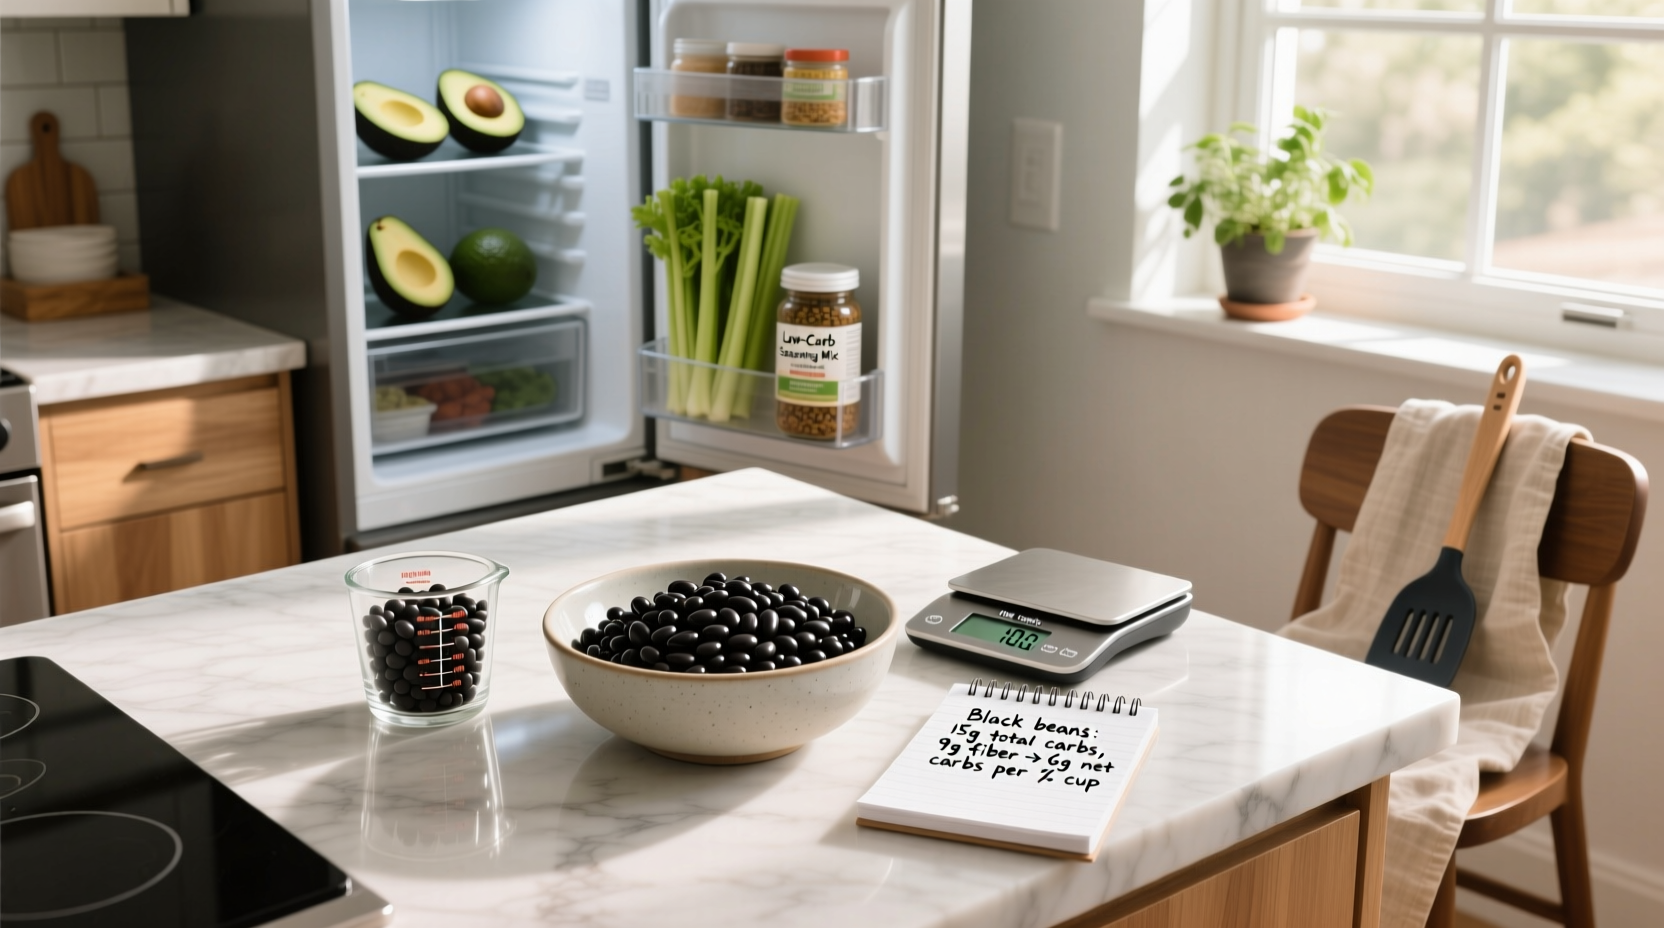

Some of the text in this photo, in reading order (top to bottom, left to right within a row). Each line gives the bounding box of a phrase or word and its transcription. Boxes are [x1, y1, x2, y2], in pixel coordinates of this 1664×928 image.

[950, 723, 1105, 760] 15g total carbs,
[967, 708, 1099, 739] Black beans:
[939, 738, 1115, 773] 9g fiber 6g net
[929, 756, 984, 772] carbs
[991, 765, 1029, 780] per
[1064, 776, 1100, 793] cup
